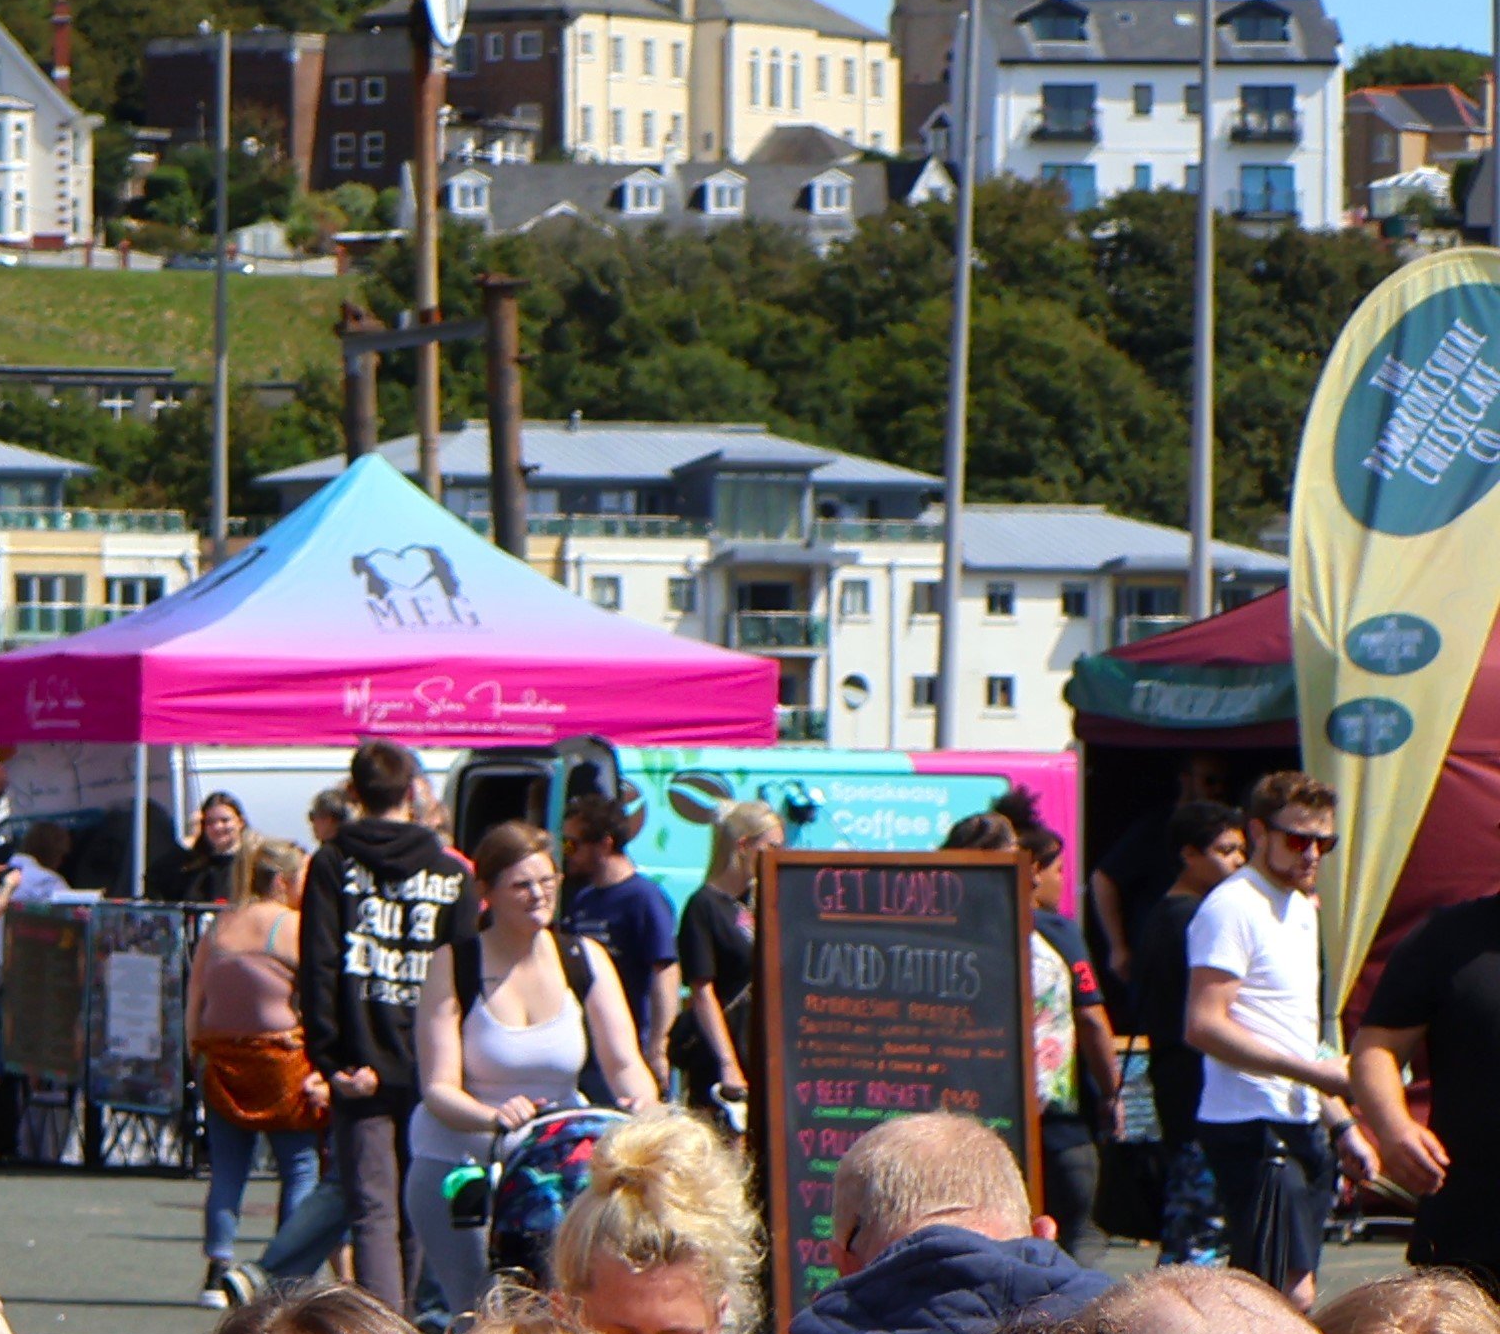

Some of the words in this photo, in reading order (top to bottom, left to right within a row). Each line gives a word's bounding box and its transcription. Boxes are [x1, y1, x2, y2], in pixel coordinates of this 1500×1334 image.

[1360, 318, 1489, 481] PEMBROKESHIRE
[831, 810, 930, 839] Coffee
[814, 867, 868, 912] GET
[802, 940, 886, 992] LOADED
